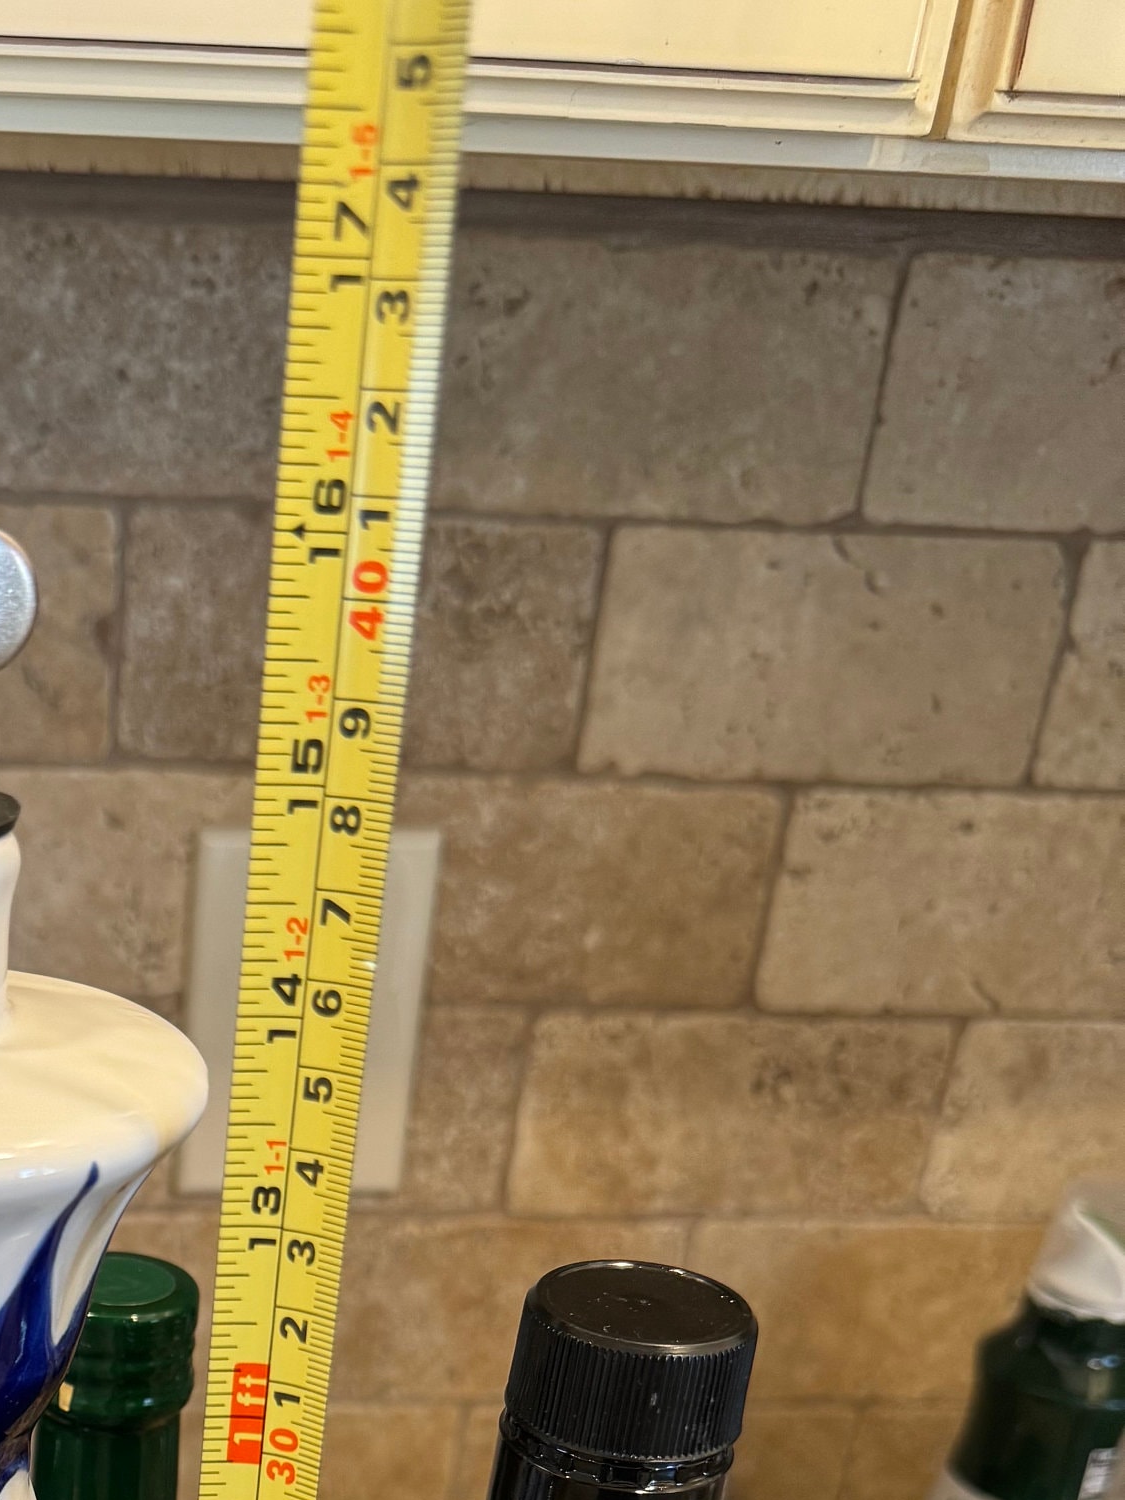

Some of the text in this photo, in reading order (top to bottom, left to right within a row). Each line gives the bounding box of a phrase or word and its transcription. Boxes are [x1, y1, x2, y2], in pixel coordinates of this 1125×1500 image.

[396, 54, 431, 89] 5
[387, 174, 421, 210] 4
[376, 290, 410, 324] 3
[367, 401, 401, 435] 2
[327, 410, 354, 462] 1-4
[359, 509, 390, 530] 1
[351, 560, 389, 640] 40
[305, 674, 331, 723] 1-3
[339, 707, 370, 739] 9
[330, 804, 362, 836] 8
[320, 898, 352, 927] 7
[283, 918, 309, 961] 1-2
[311, 990, 342, 1019] 6
[303, 1076, 334, 1104] 5
[295, 1159, 325, 1187] 4
[287, 1239, 316, 1267] 3
[280, 1317, 308, 1344] 2
[273, 1391, 301, 1408] 1
[266, 1428, 299, 1485] 30
